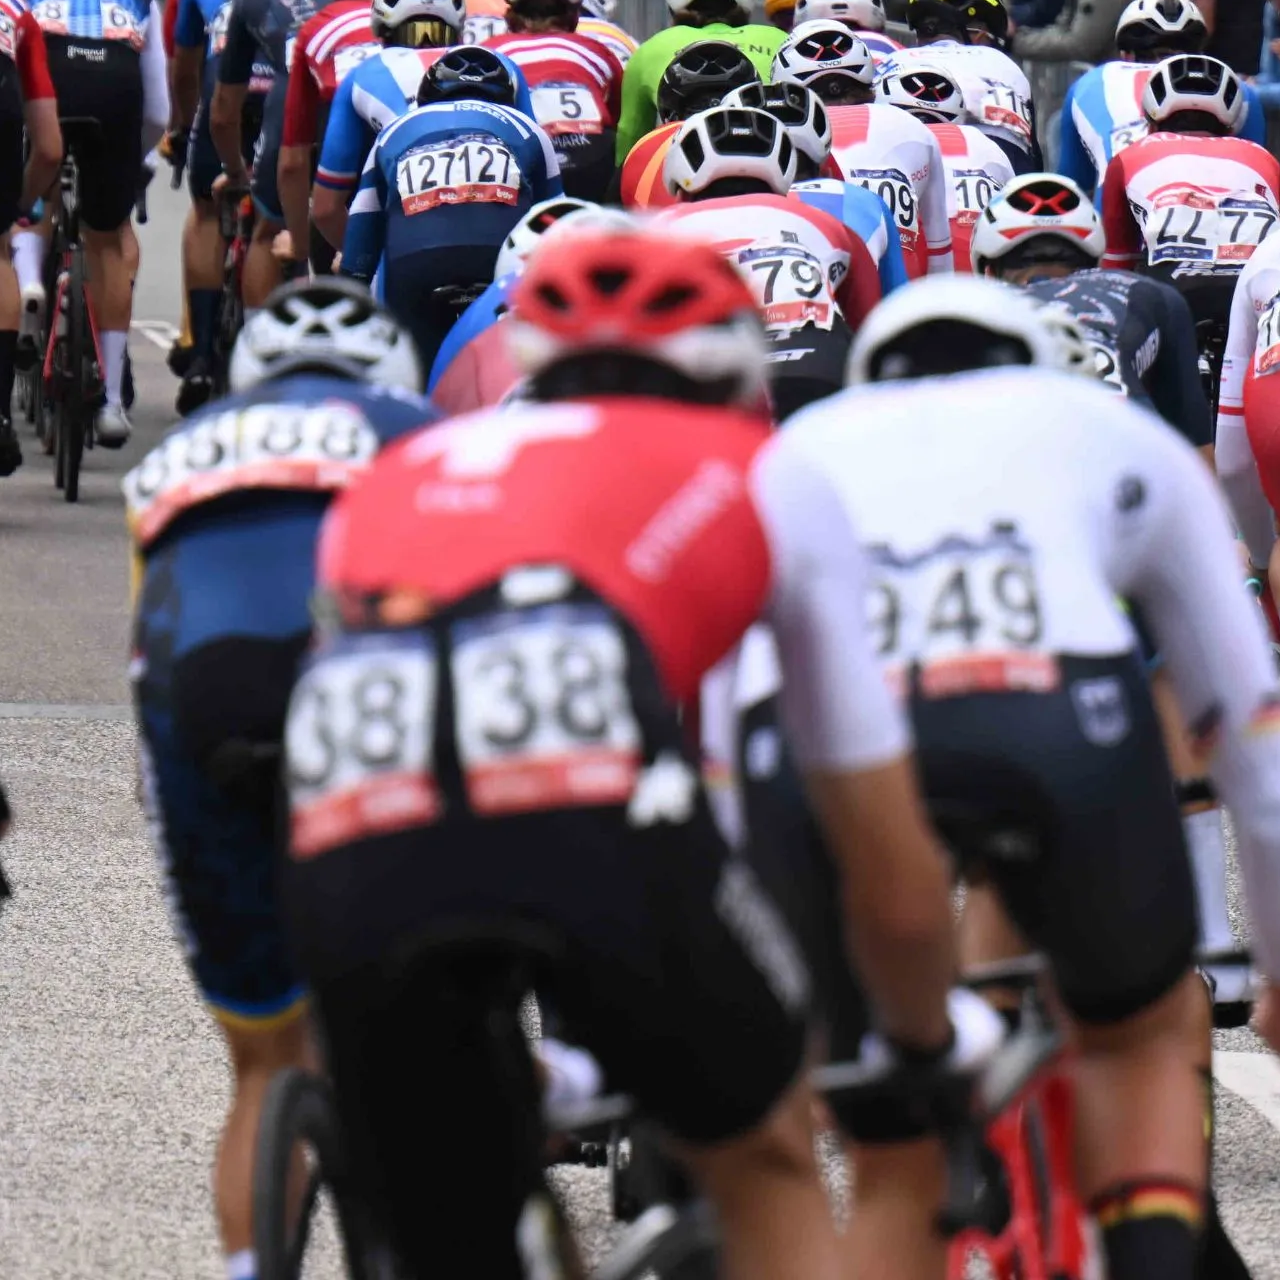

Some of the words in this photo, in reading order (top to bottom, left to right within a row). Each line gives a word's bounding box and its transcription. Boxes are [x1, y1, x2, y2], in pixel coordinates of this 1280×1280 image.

[455, 102, 509, 125] ISRAEL
[558, 91, 583, 120] 5
[401, 151, 456, 195] 127
[459, 145, 510, 184] 127
[861, 180, 914, 228] 09
[955, 179, 1000, 210] 10
[1224, 210, 1277, 244] 77
[751, 260, 824, 306] 79
[926, 564, 1045, 647] 49
[475, 641, 613, 746] 38
